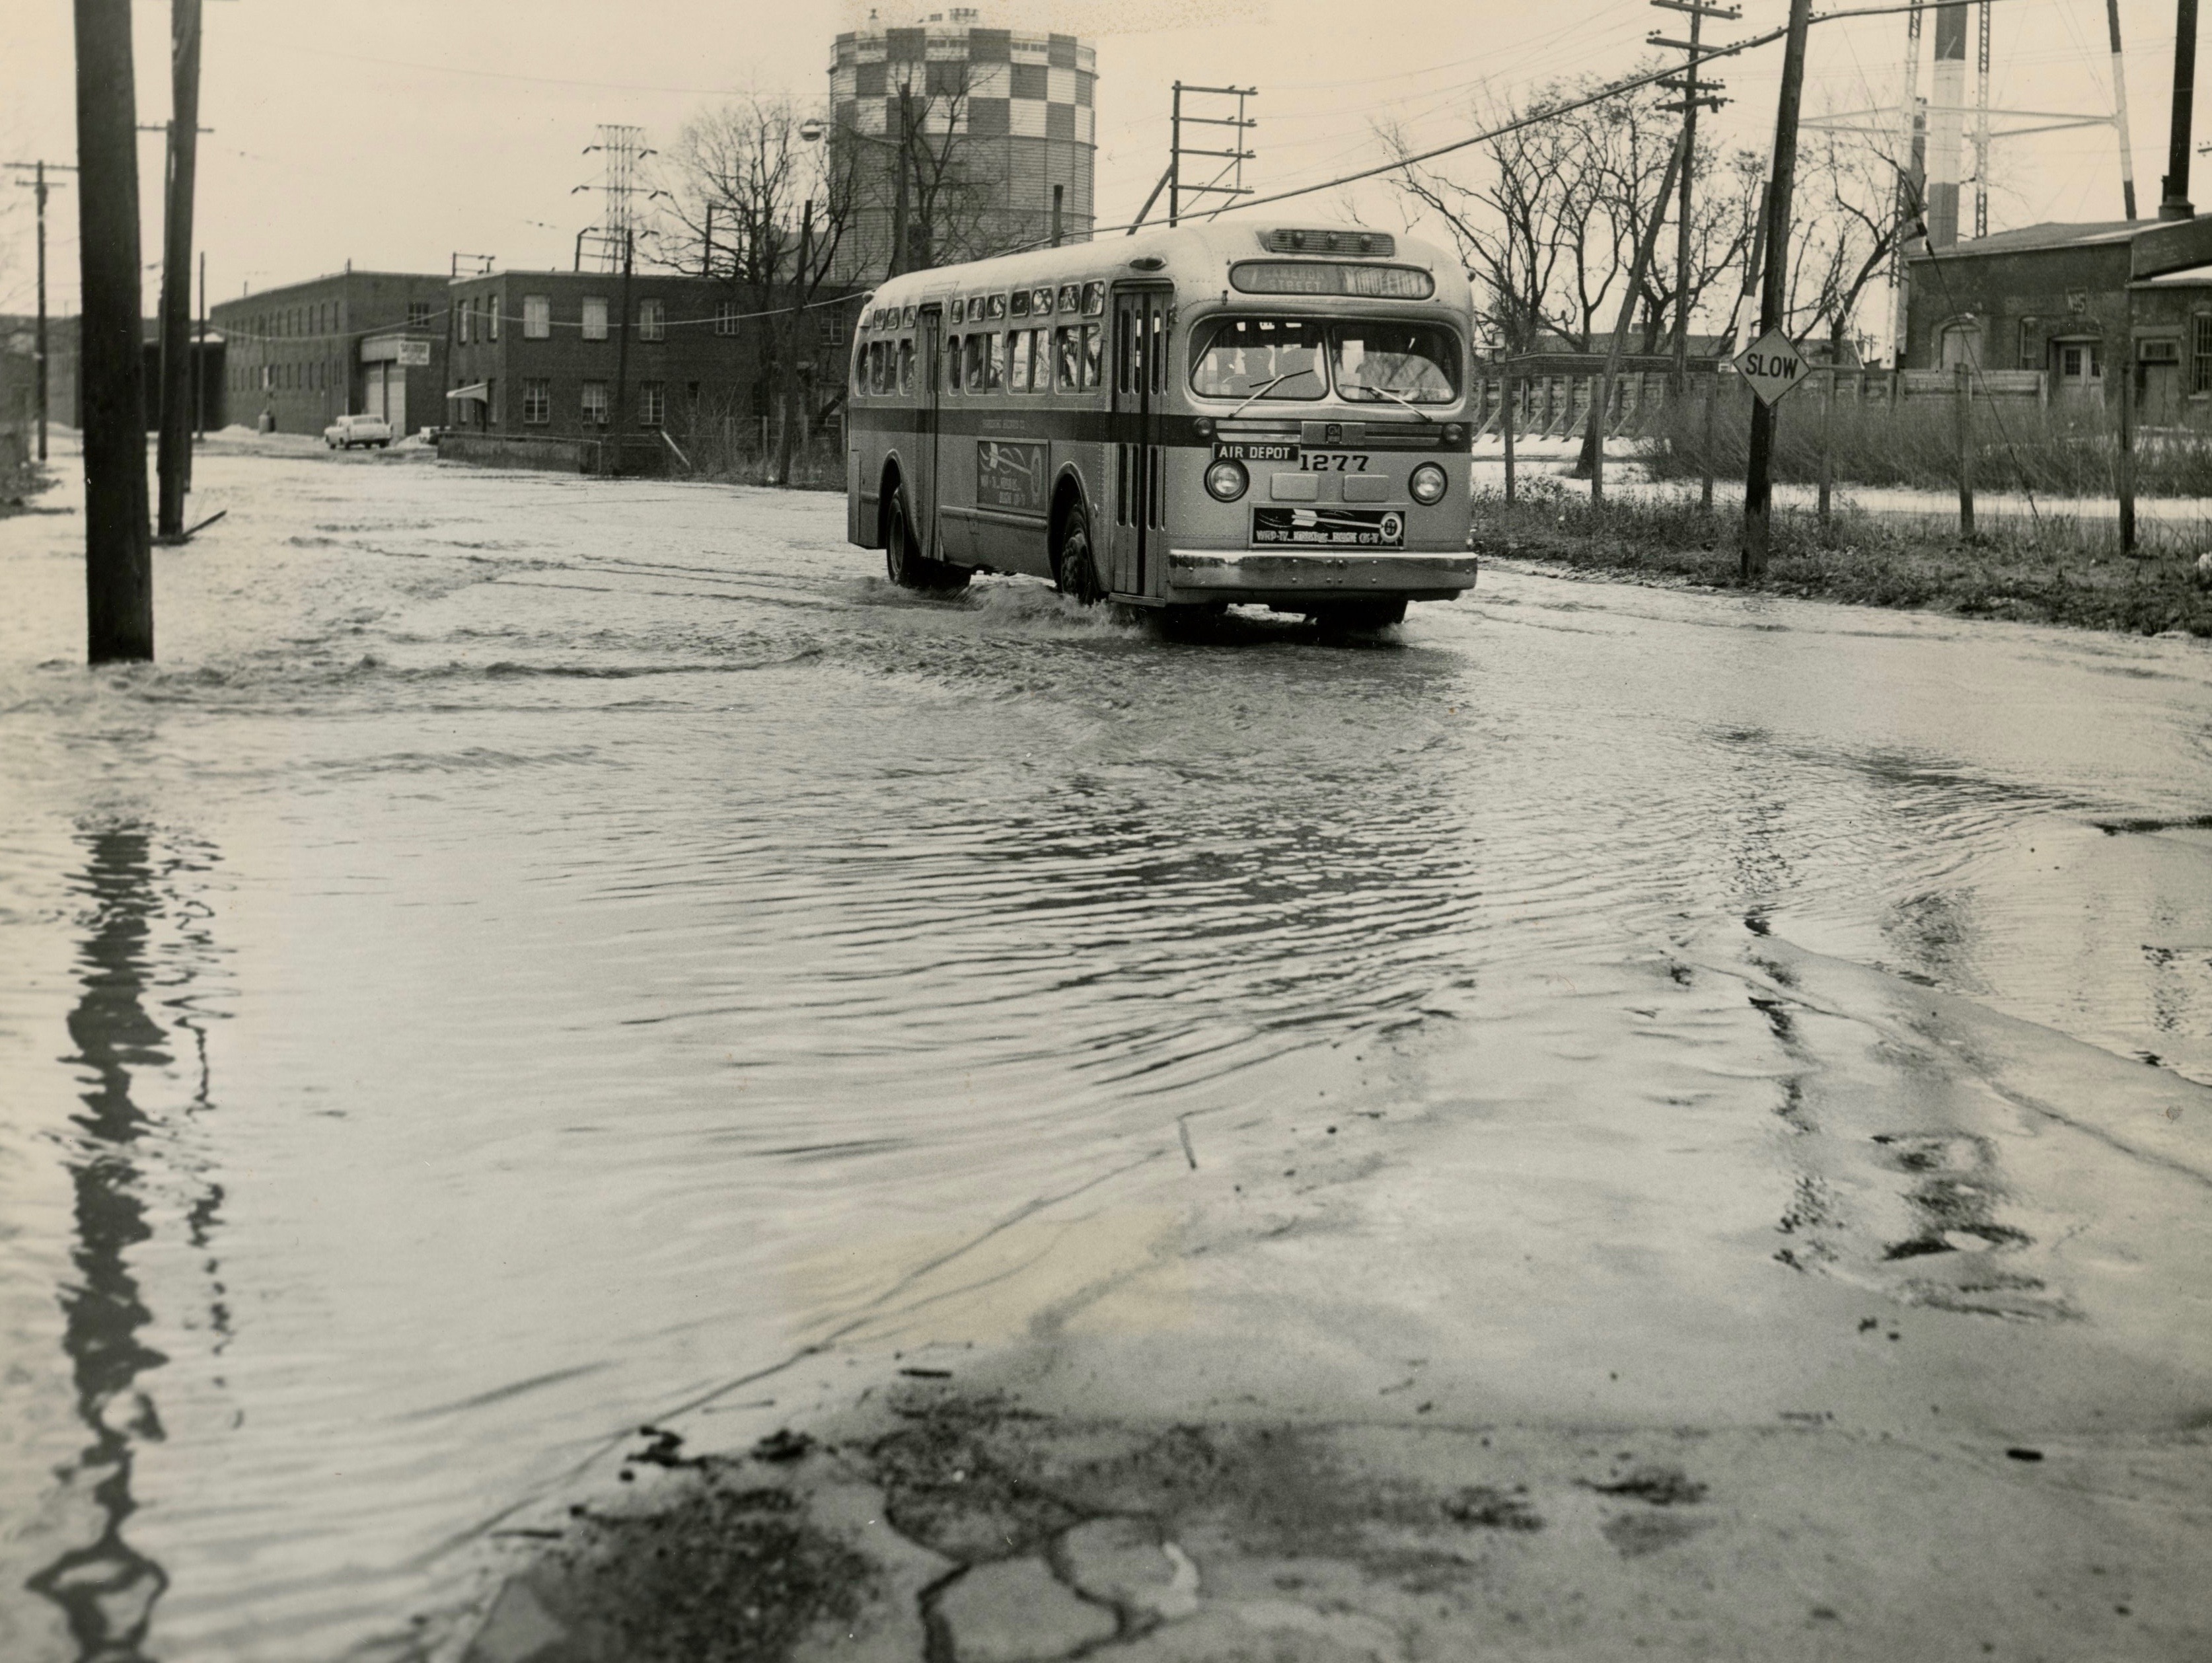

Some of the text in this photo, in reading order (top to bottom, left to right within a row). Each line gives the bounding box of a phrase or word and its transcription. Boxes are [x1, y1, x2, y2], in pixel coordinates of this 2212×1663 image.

[1269, 279, 1321, 292] STREET
[1746, 353, 1798, 379] SLOW
[1219, 446, 1290, 459] AIR DEPOT
[1300, 454, 1370, 472] 1277
